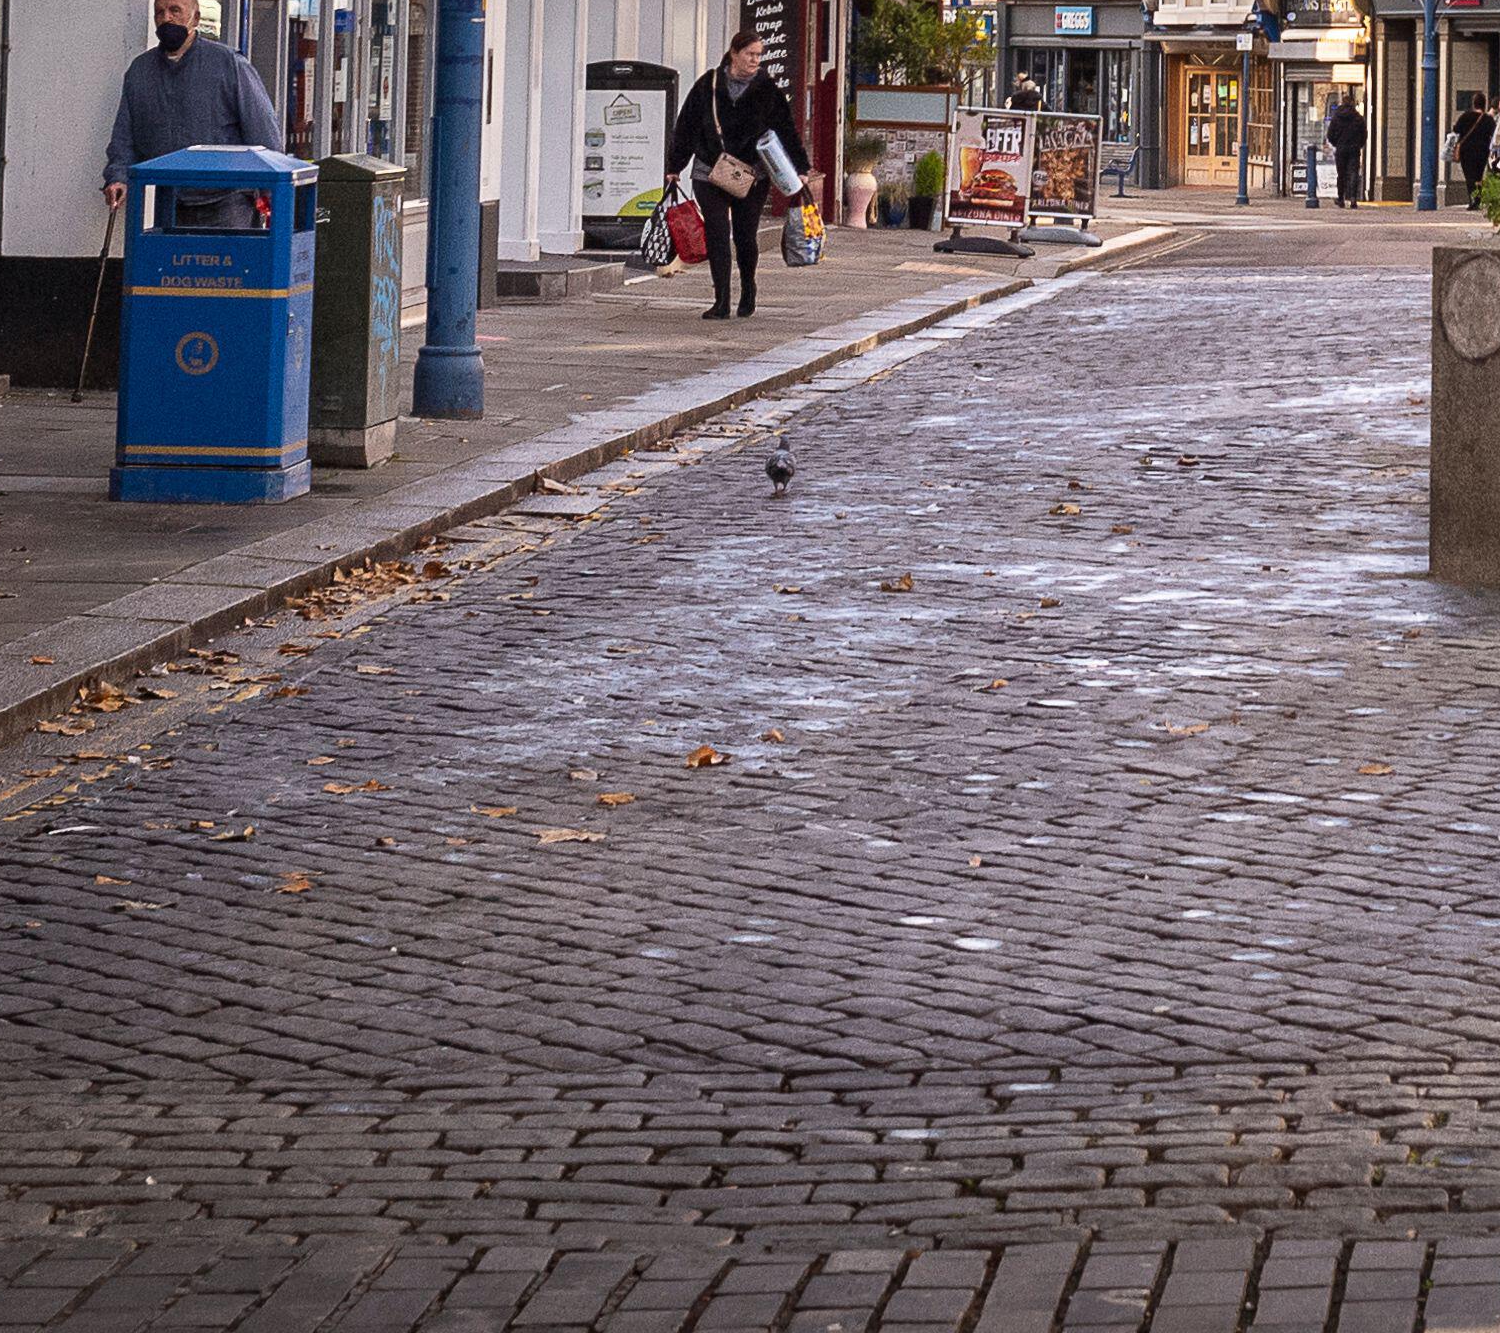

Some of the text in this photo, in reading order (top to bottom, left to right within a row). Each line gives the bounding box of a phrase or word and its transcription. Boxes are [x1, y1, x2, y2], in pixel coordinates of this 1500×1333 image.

[755, 1, 784, 18] Kebab
[986, 128, 1022, 154] BEER
[172, 254, 233, 267] LITTER &
[160, 276, 244, 289] DOG WASTE
